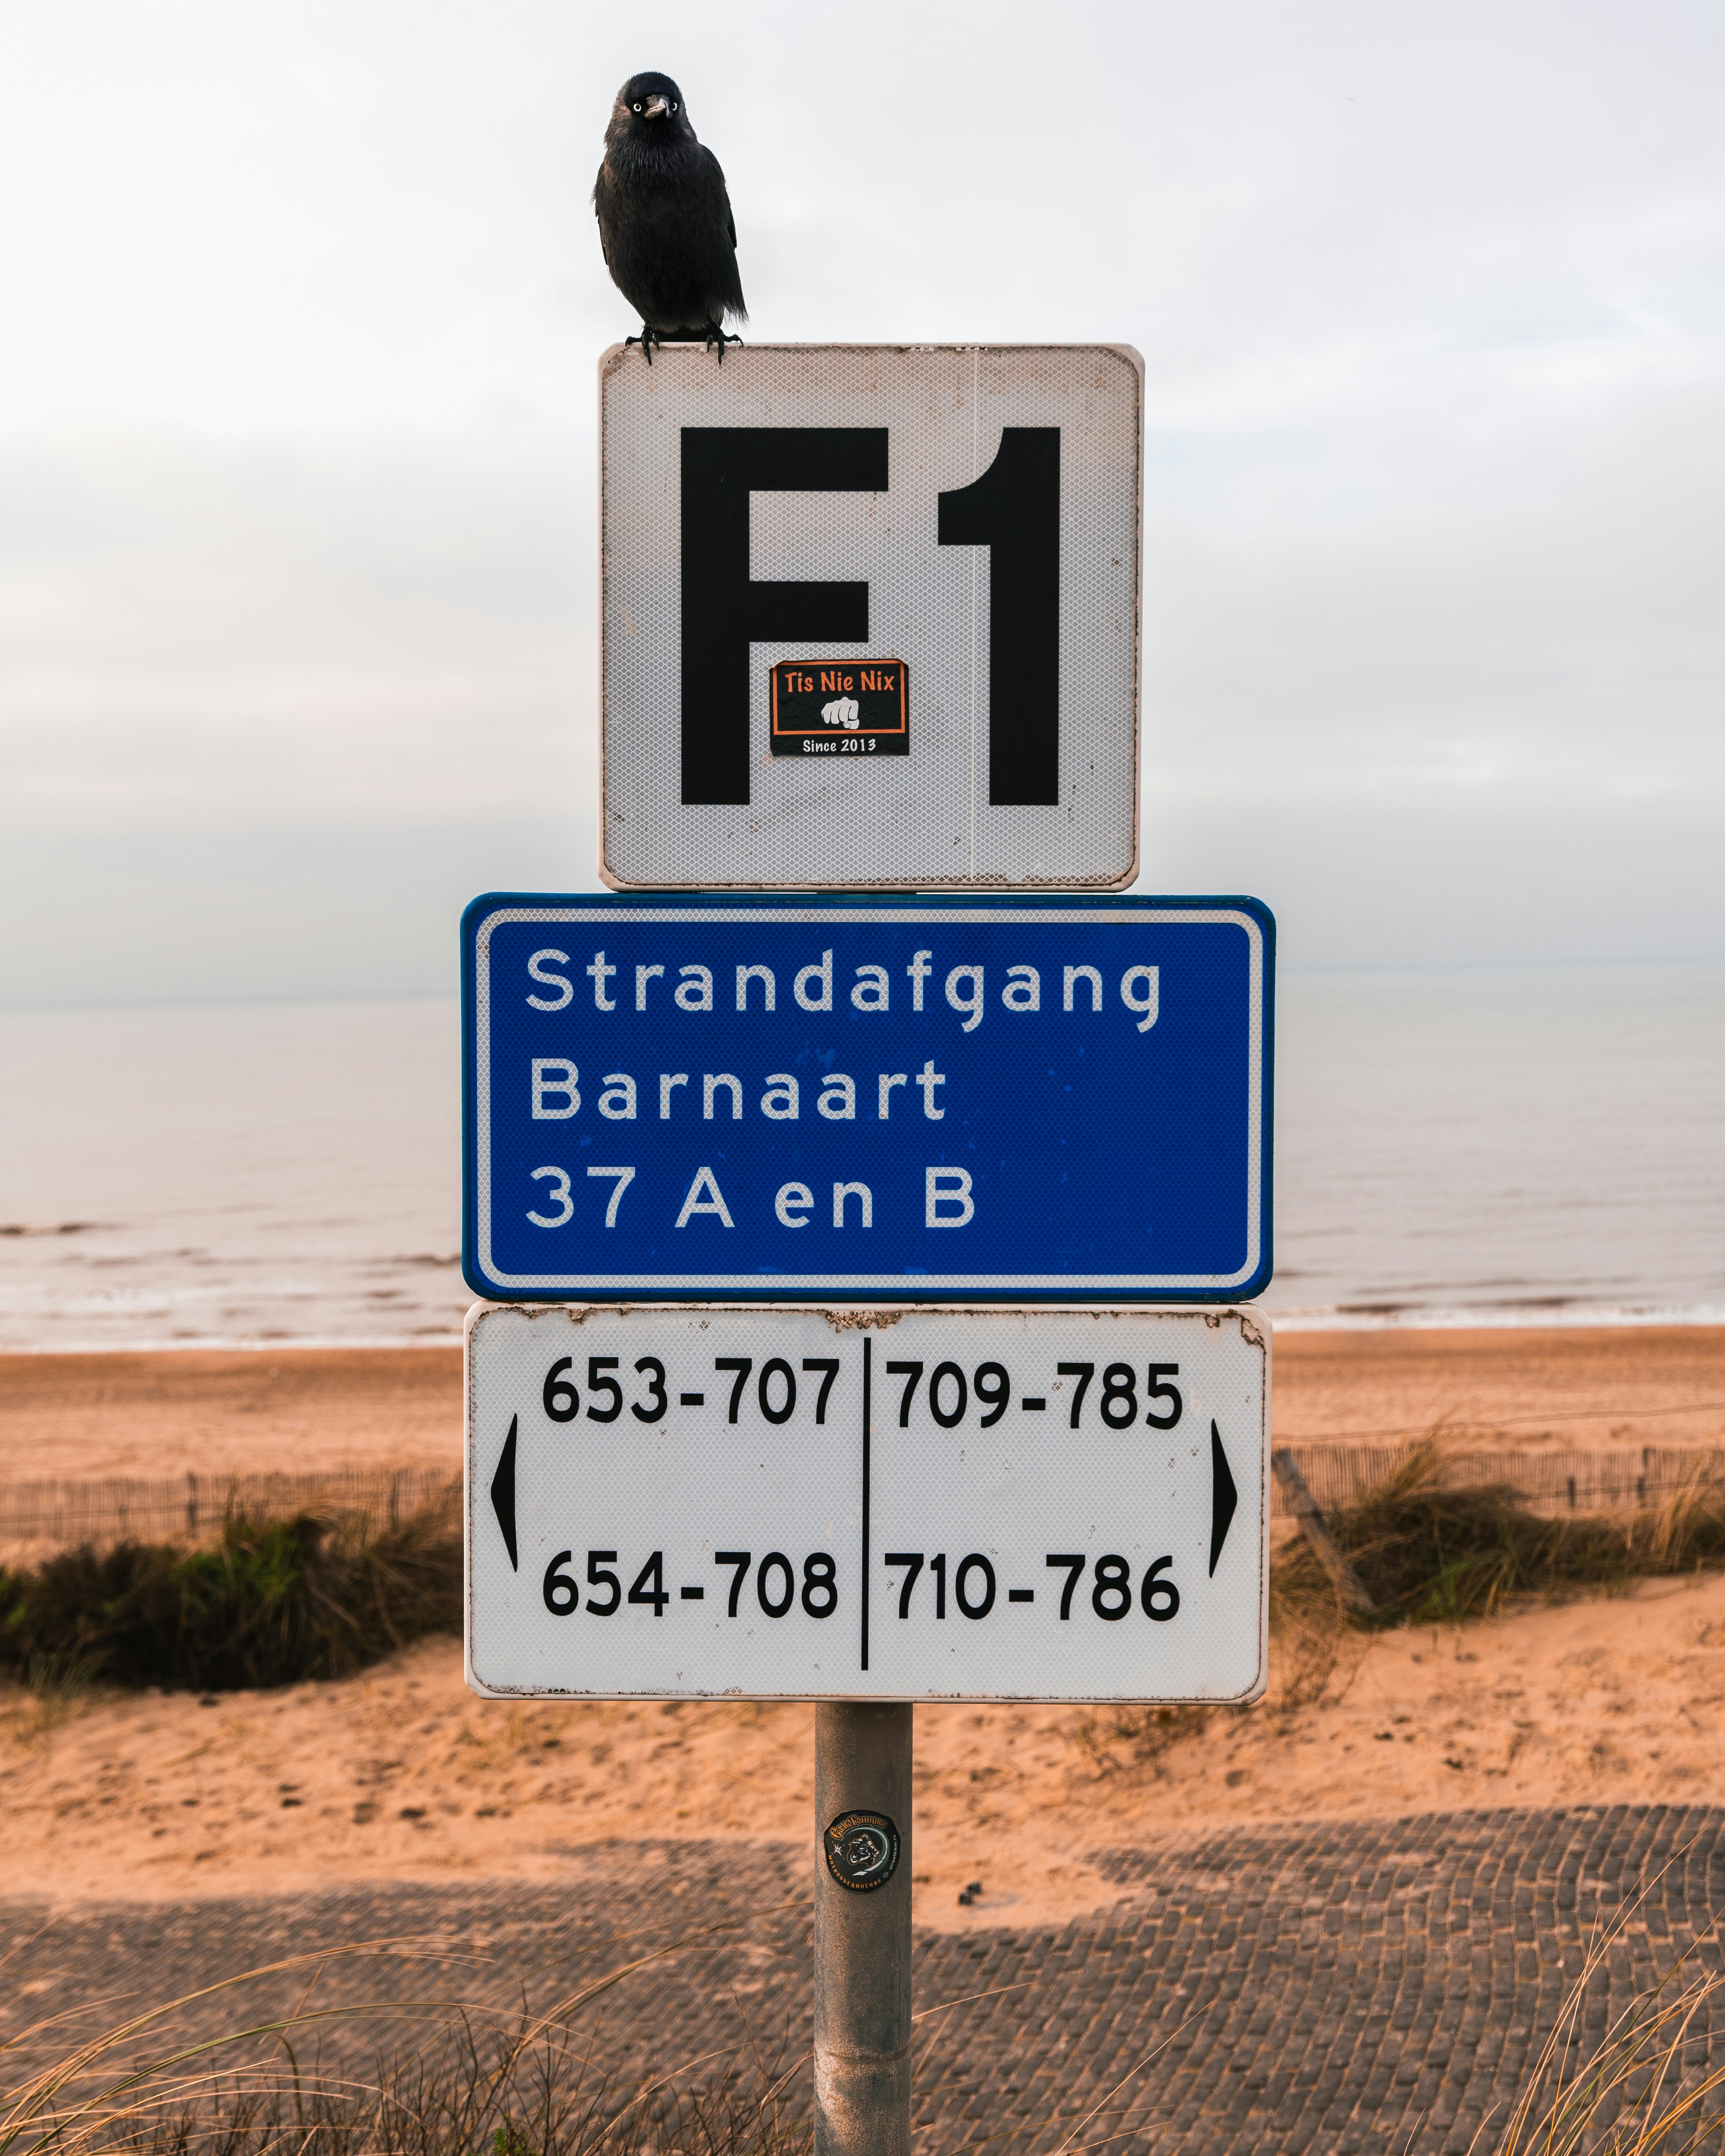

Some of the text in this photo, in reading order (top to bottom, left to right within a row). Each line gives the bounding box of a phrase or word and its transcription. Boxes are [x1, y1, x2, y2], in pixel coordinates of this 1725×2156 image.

[681, 427, 1060, 806] F1
[785, 670, 895, 692] Tis Nie Nix
[802, 738, 876, 752] Since 2013
[526, 949, 1160, 1033] Strandafgang
[532, 1058, 945, 1120] Barnaart
[526, 1166, 974, 1228] 37 A en B
[543, 1356, 840, 1425] 653-707
[886, 1361, 1183, 1430] 709-785
[543, 1550, 838, 1619] 654-708
[885, 1553, 1180, 1622] 710-786
[828, 1855, 882, 1889] МОТООБЪЕДИНЕНИЕ
